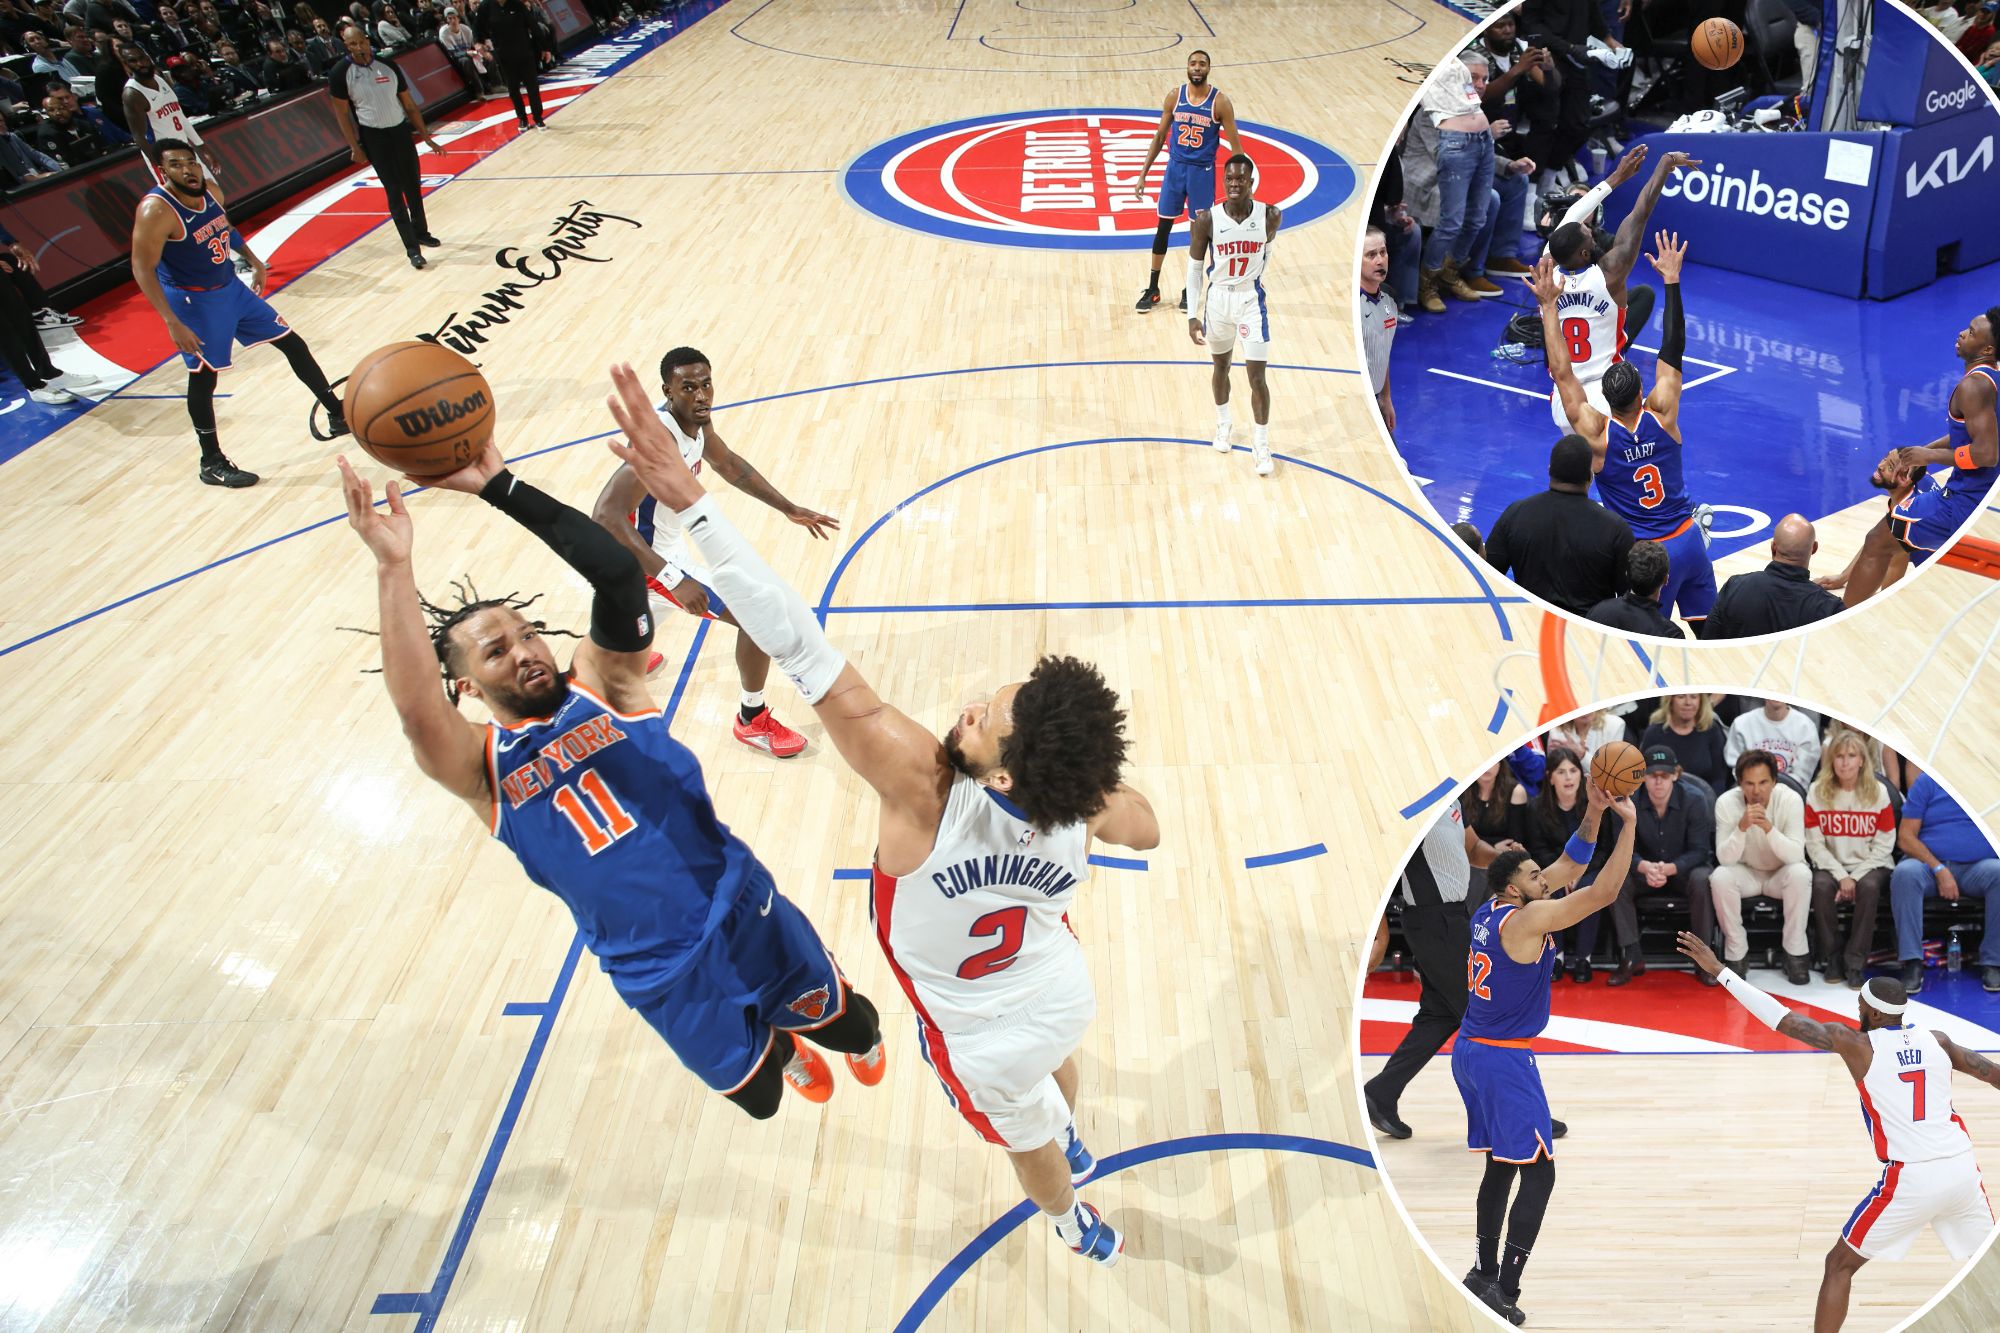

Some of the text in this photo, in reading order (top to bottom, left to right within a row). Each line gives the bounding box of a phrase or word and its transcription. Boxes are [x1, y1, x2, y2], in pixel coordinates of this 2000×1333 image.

[1926, 80, 1976, 113] Google
[172, 116, 183, 131] 8
[1178, 124, 1204, 148] 25
[1190, 113, 1211, 127] YORK
[1020, 130, 1096, 212] DETROIT
[1906, 135, 1993, 198] KIA
[1660, 161, 1850, 231] coinbase
[1216, 240, 1263, 256] PISTONS
[1228, 257, 1249, 277] 17
[1562, 317, 1592, 363] 8
[394, 389, 488, 438] Wilson
[1624, 442, 1656, 463] HART
[1632, 463, 1666, 510] 3
[538, 712, 629, 774] YORK
[552, 767, 639, 858] 11
[1819, 813, 1877, 835] PISTONS
[931, 853, 1078, 900] CUNNINGHAM
[956, 905, 1029, 981] 2
[1896, 1049, 1922, 1066] REED
[1898, 1069, 1927, 1122] 7
